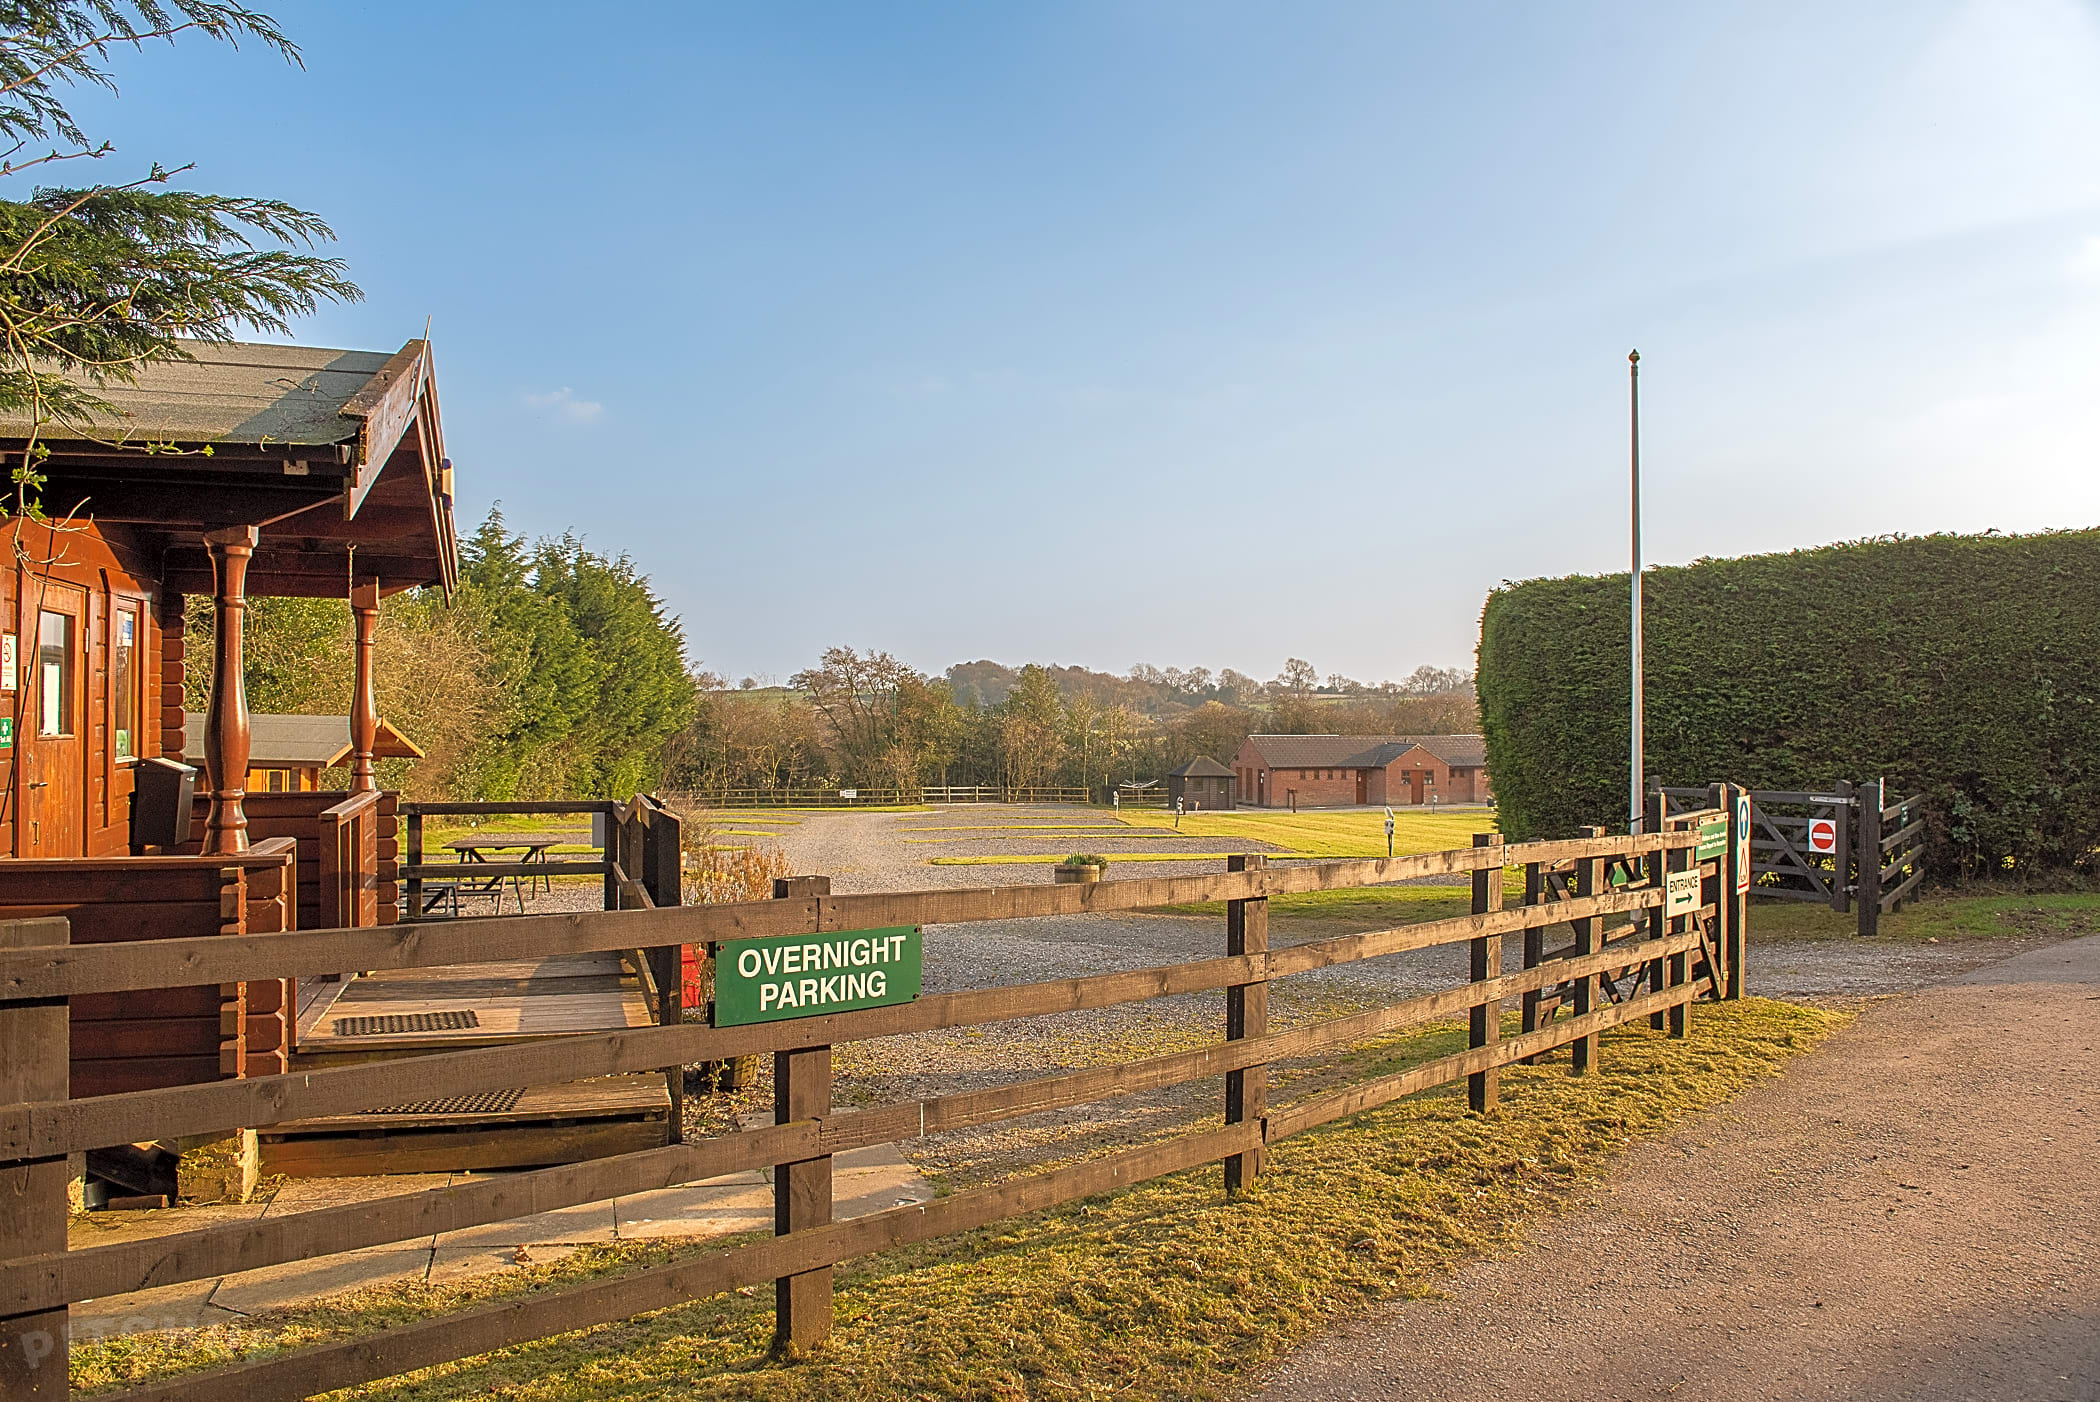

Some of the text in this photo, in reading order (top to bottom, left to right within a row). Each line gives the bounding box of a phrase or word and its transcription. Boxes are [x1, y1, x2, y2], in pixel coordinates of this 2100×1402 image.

[1669, 875, 1699, 893] ENTRANCE
[737, 935, 907, 978] OVERNIGHT
[760, 970, 887, 1012] PARKING
